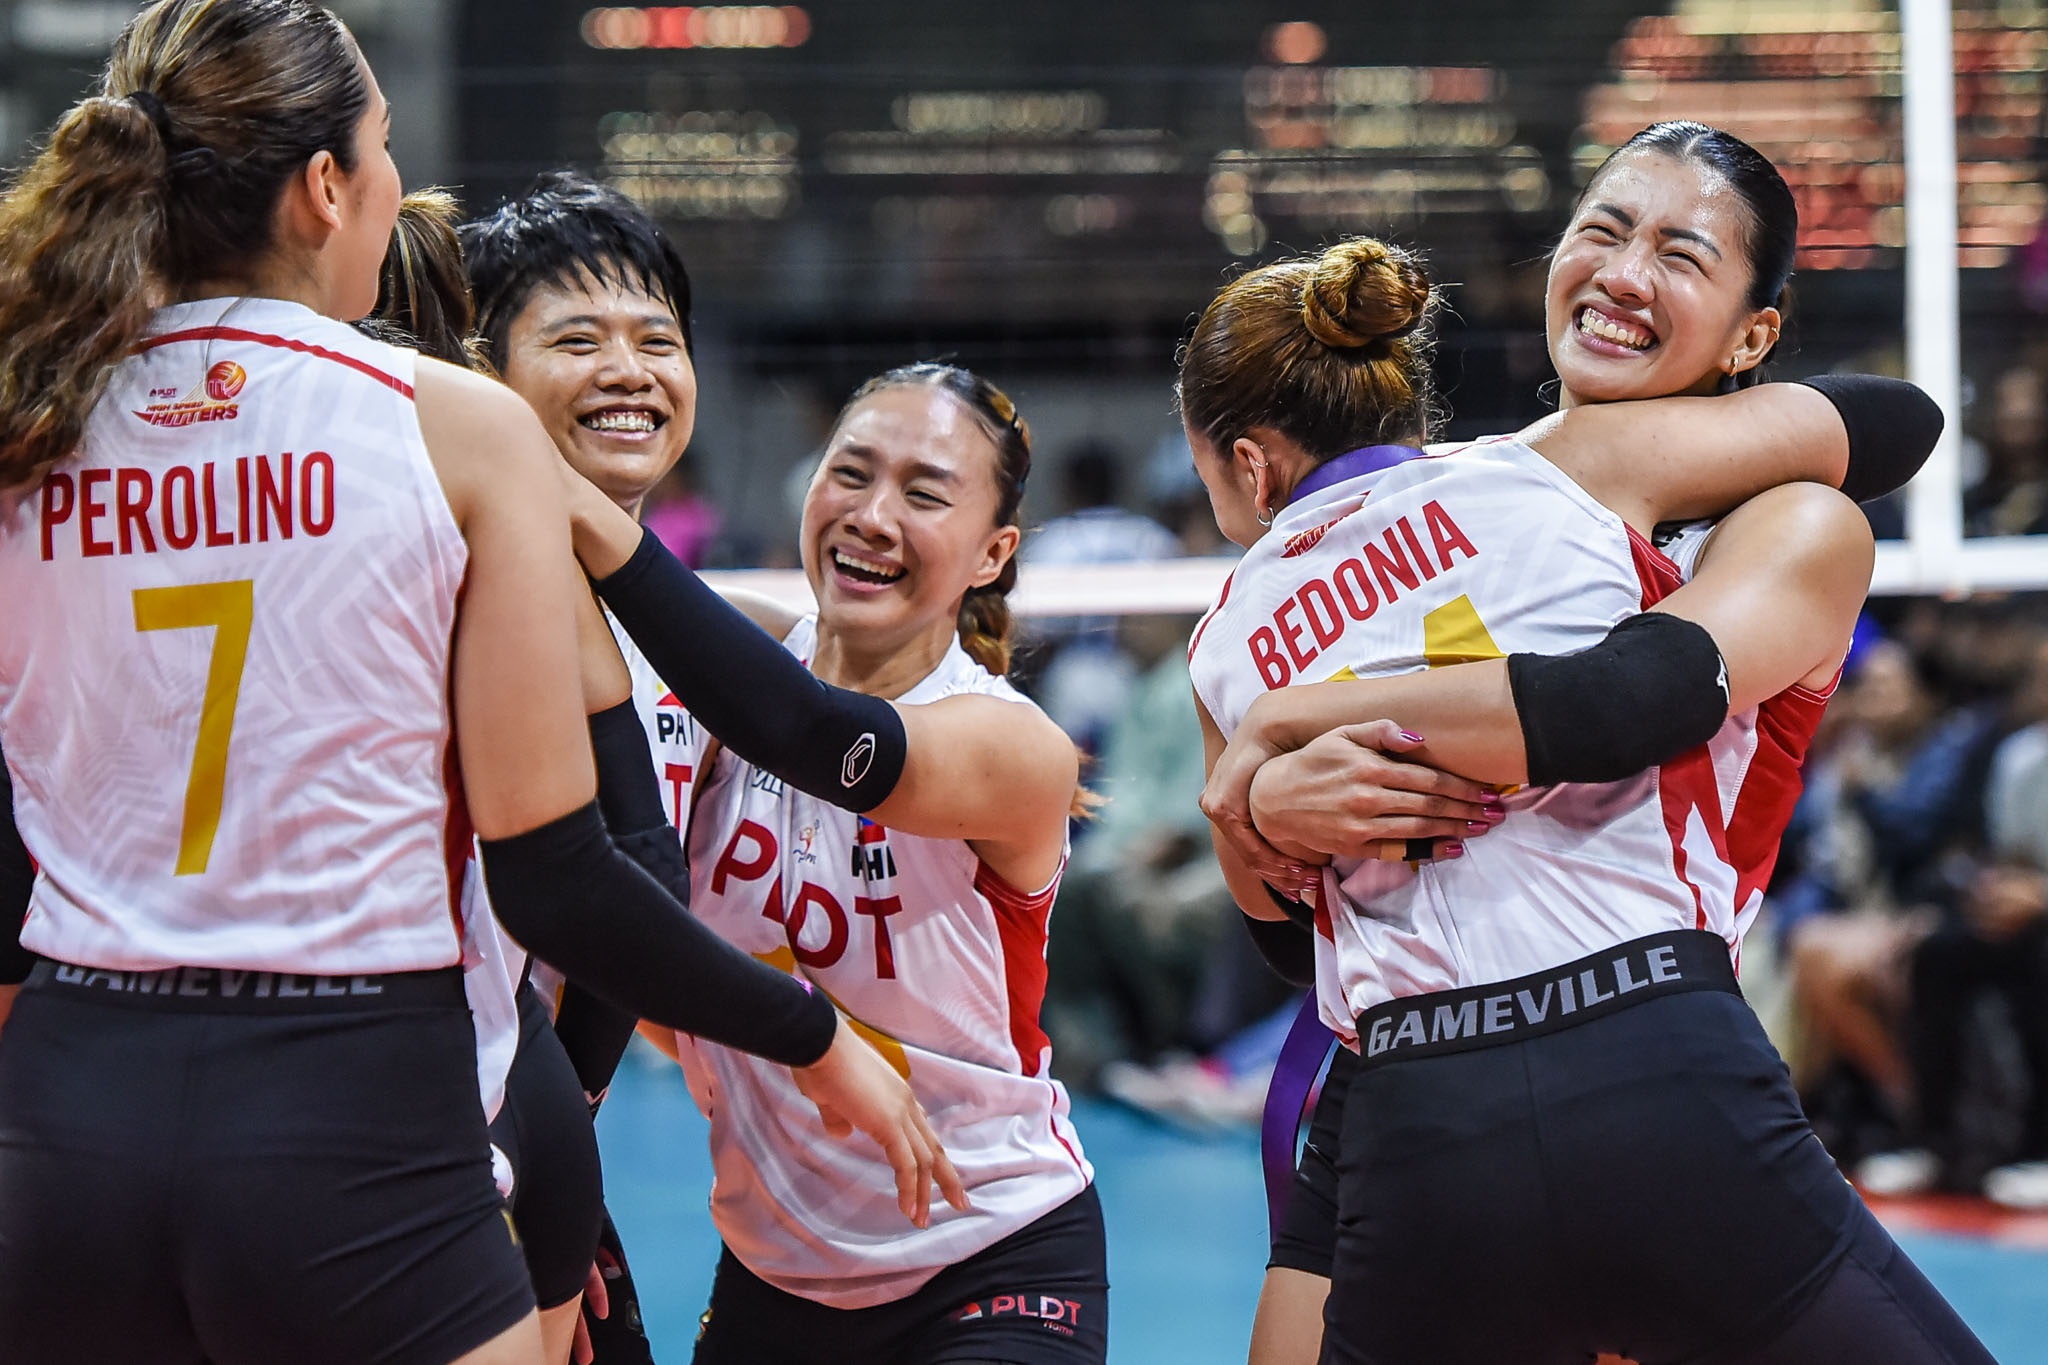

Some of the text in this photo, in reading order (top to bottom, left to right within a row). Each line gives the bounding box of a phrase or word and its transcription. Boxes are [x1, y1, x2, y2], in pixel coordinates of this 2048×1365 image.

[146, 403, 171, 412] HIGH
[151, 404, 239, 426] HITTERS
[40, 450, 335, 562] PEROLINO
[1247, 499, 1479, 691] BEDONIA
[132, 579, 253, 876] 7
[1367, 945, 1682, 1058] GAMEVILLE
[991, 1295, 1081, 1326] PLDT
